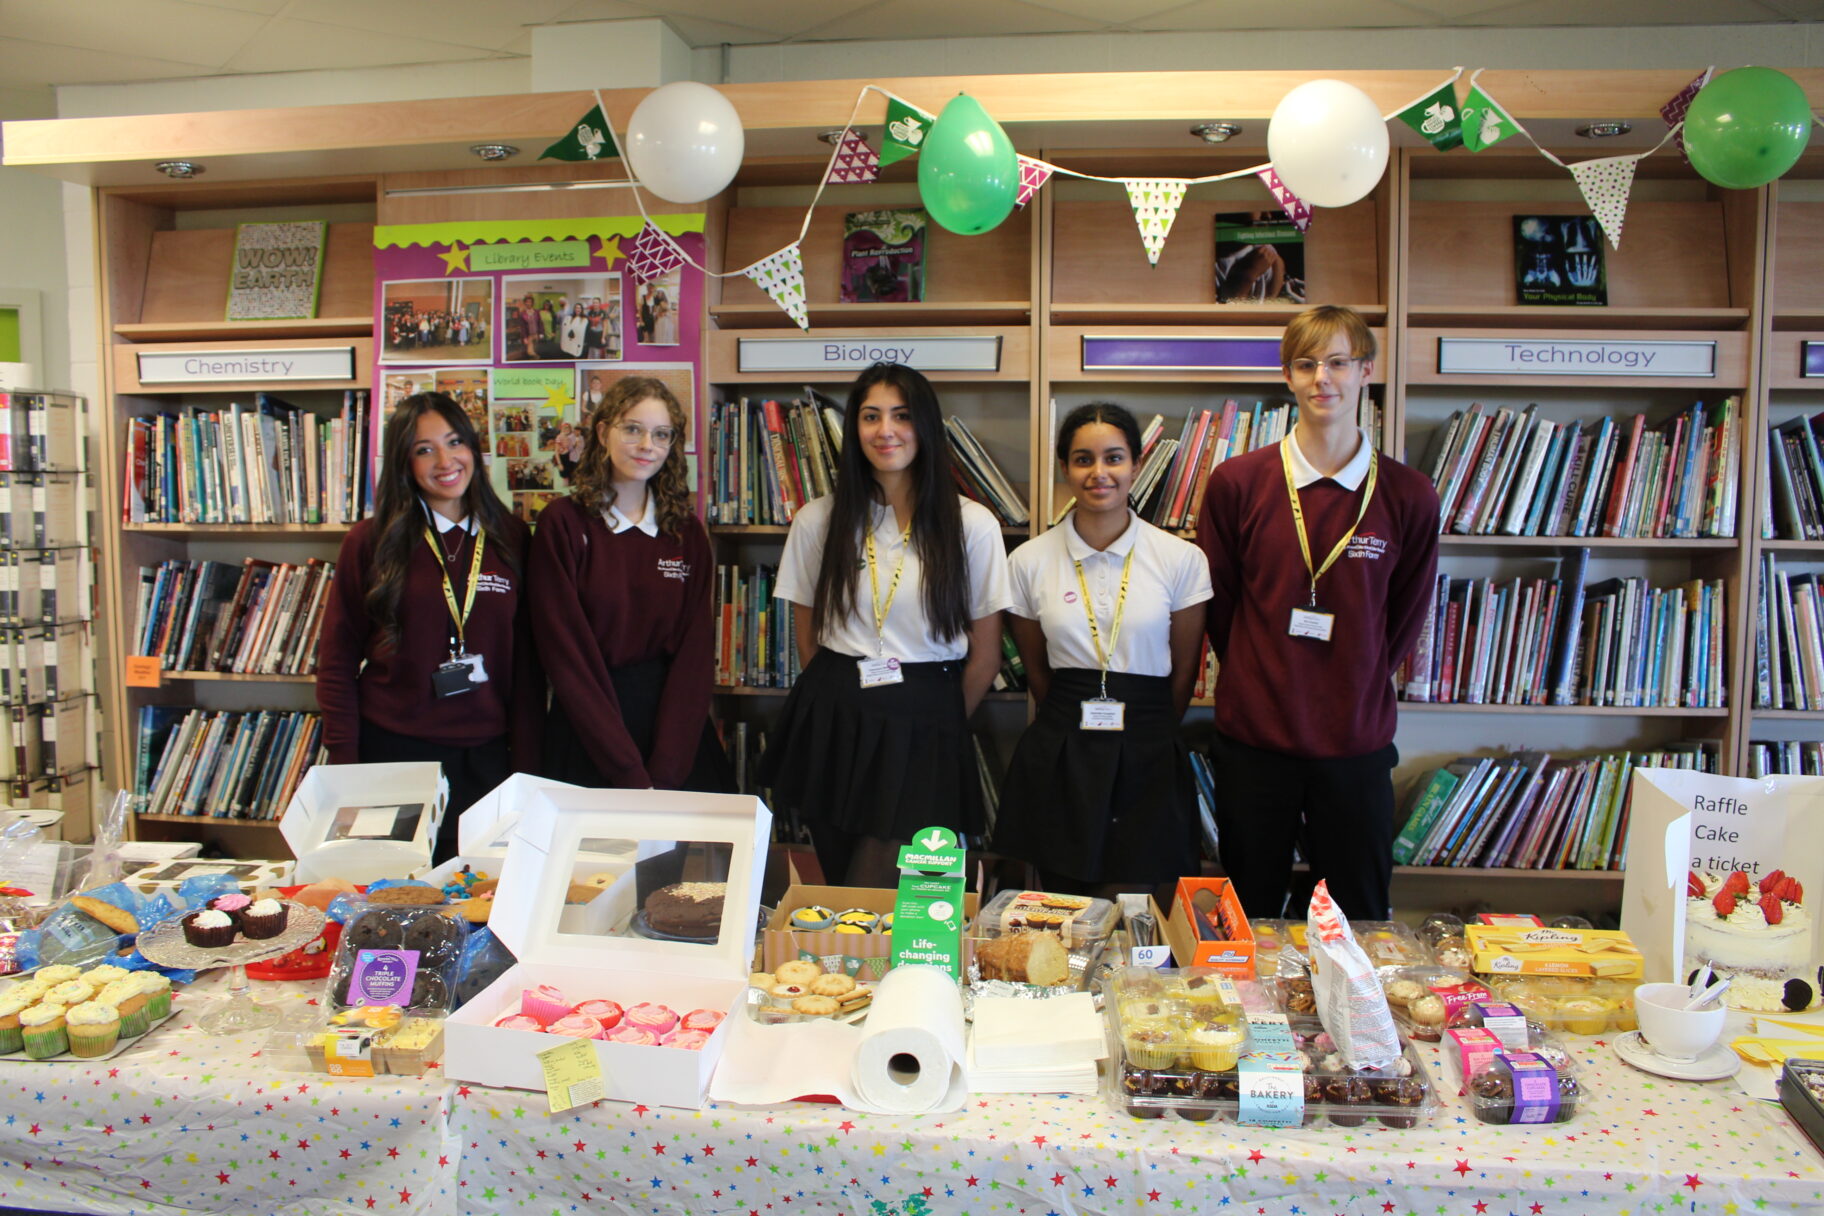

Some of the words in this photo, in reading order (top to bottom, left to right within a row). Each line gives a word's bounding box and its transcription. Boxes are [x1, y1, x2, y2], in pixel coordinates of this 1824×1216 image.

[238, 246, 317, 269] WOW!
[485, 252, 529, 267] Library
[534, 251, 575, 262] Events
[234, 269, 314, 290] EARTH
[824, 344, 914, 364] Biology
[1505, 345, 1656, 367] Technology
[184, 358, 294, 375] Chemistry
[1694, 795, 1748, 816] Raffle
[1695, 825, 1739, 843] Cake
[905, 853, 957, 863] MACMILLAN
[1692, 857, 1702, 868] a
[1708, 856, 1760, 874] ticket
[912, 938, 937, 949] Life-
[1525, 932, 1578, 941] Kipling
[899, 949, 950, 963] changing
[1138, 949, 1153, 959] 60
[1446, 994, 1467, 1004] Free
[1467, 992, 1488, 1001] From
[1250, 1089, 1293, 1099] BAKERY
